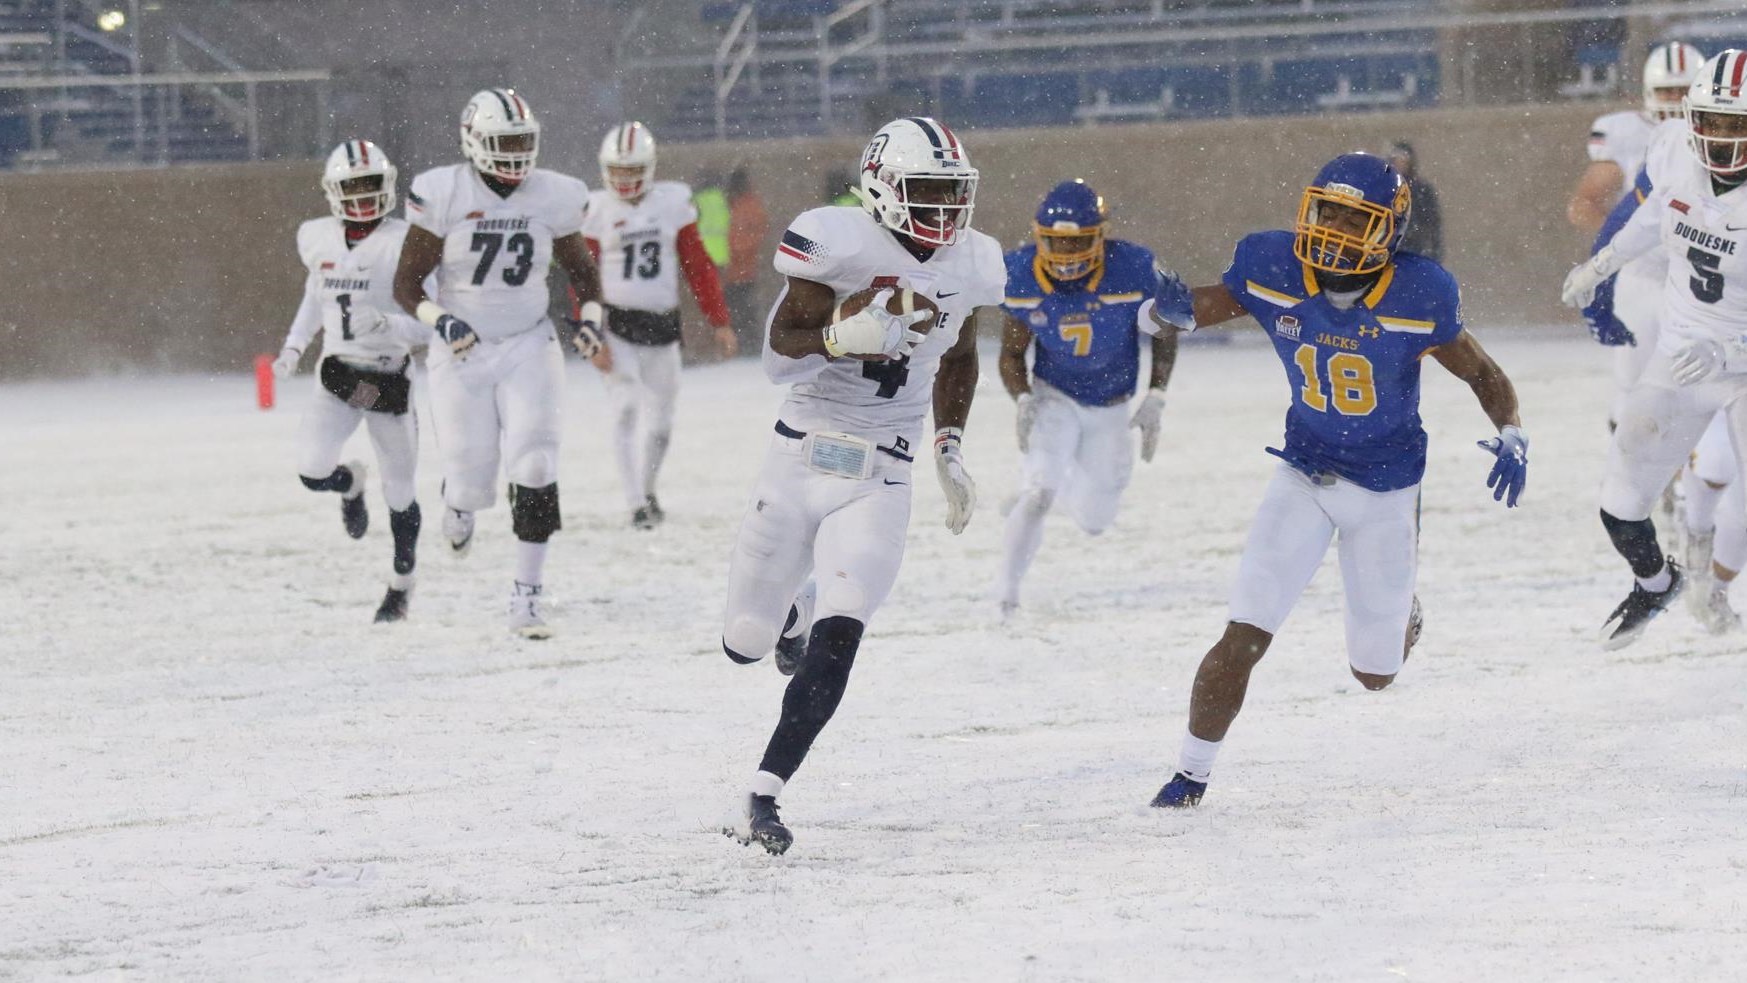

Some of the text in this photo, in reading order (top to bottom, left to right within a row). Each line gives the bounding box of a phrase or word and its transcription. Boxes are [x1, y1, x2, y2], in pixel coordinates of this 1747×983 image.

[1674, 221, 1737, 255] DUQUESNE
[470, 232, 534, 286] 73
[623, 241, 660, 279] 13
[1687, 246, 1725, 304] 5
[336, 294, 355, 340] 1
[1275, 319, 1302, 337] VALLEY
[1058, 323, 1093, 356] 7
[1315, 332, 1359, 350] JACKS
[1295, 343, 1377, 416] 18
